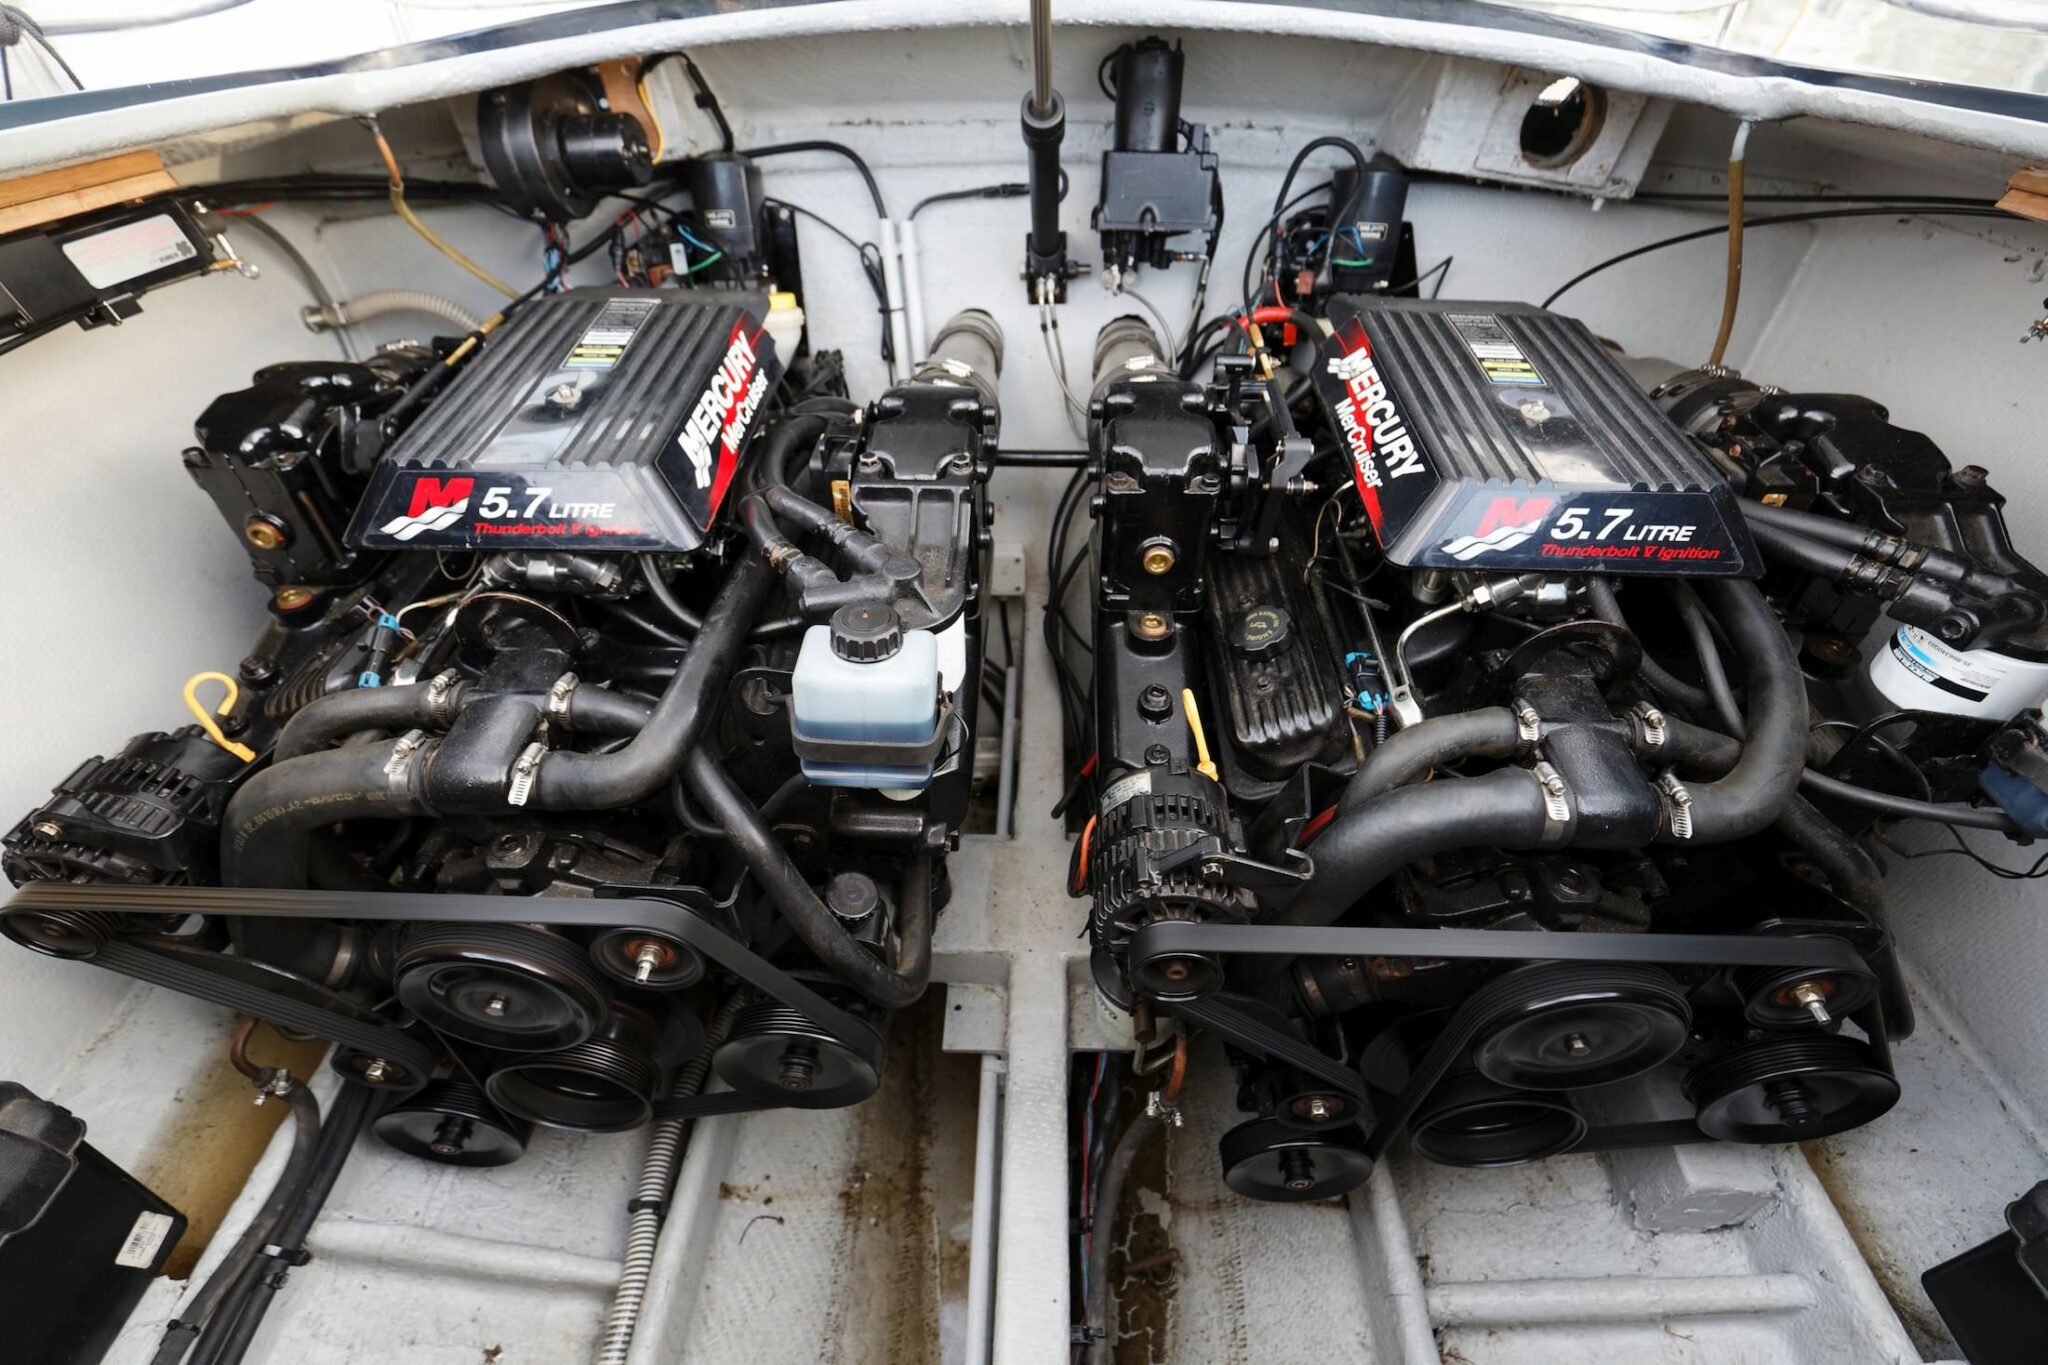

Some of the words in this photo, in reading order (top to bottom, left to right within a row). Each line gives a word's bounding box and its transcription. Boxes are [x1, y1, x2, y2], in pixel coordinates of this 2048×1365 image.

[677, 330, 756, 471] MERCURY
[720, 367, 769, 455] MerCruiser
[1341, 346, 1426, 479] MERCURY
[1334, 397, 1384, 489] MerCruiser
[474, 522, 567, 536] Thunderbolt
[478, 486, 552, 519] 5.7
[548, 502, 616, 519] LITRE
[1550, 507, 1634, 540] 5.7
[1622, 525, 1697, 542] LITRE
[1539, 543, 1641, 558] Thunderbolt
[1643, 545, 1656, 558] V
[1657, 546, 1721, 561] Ignition
